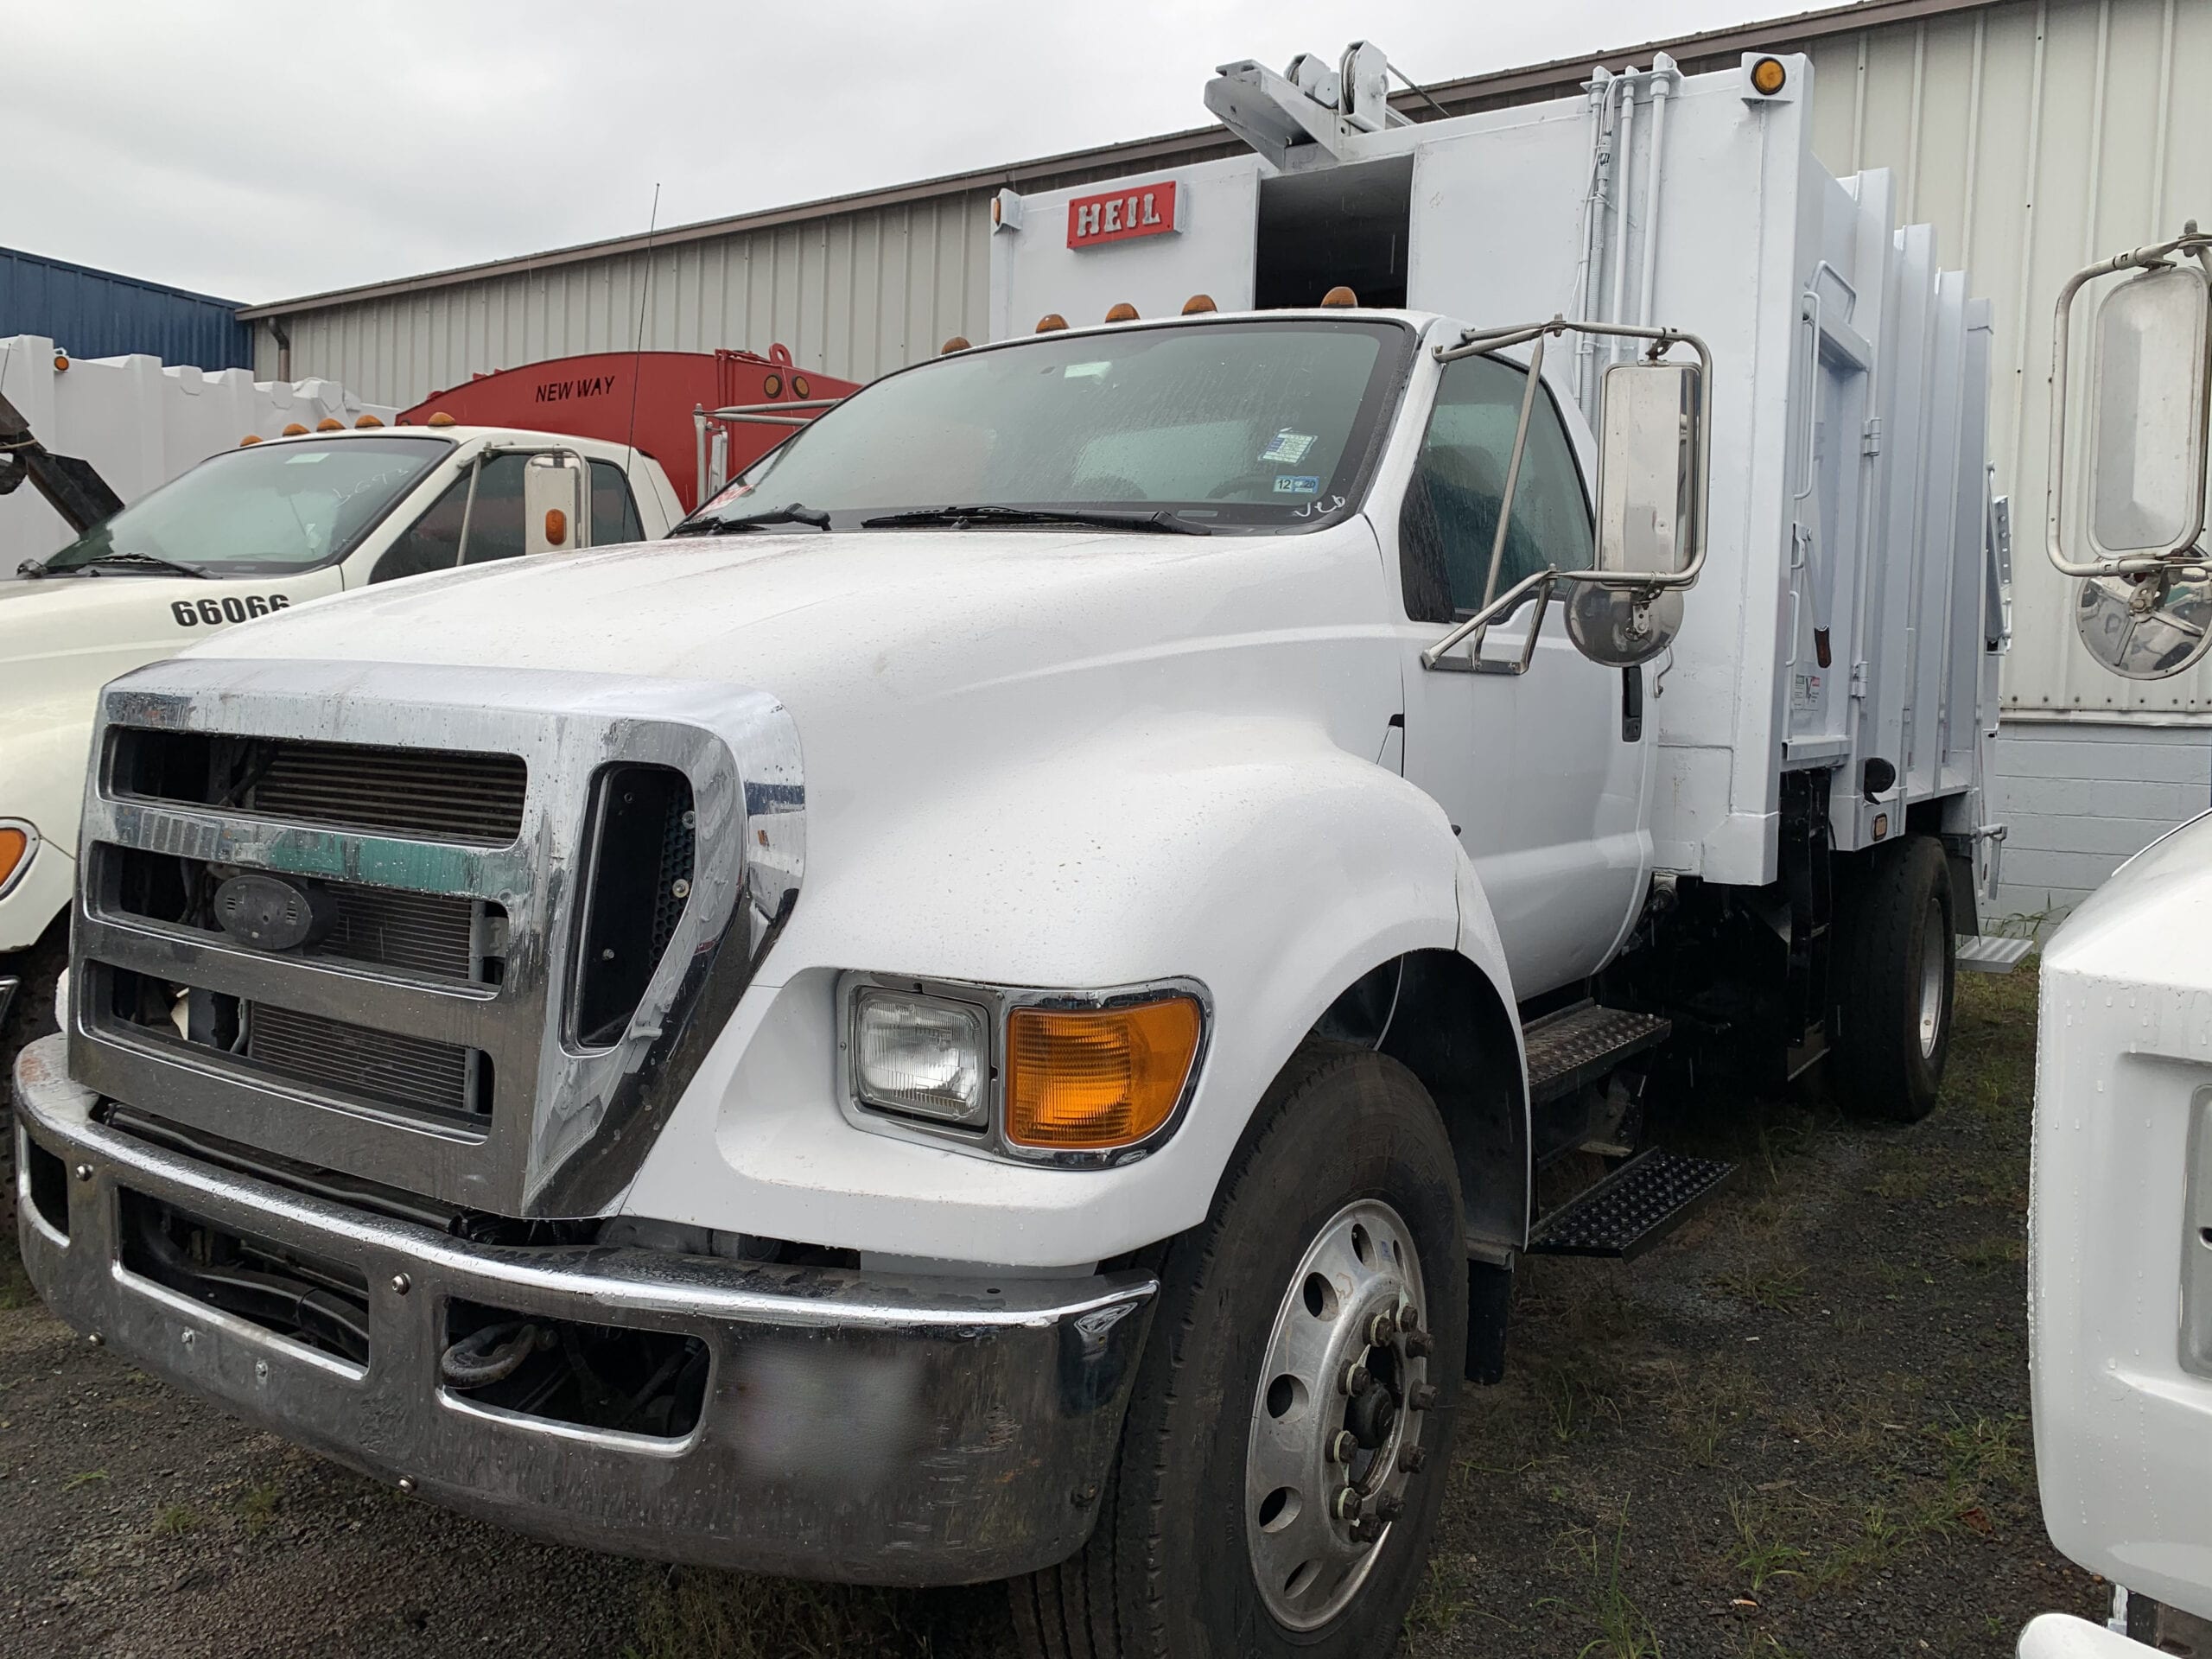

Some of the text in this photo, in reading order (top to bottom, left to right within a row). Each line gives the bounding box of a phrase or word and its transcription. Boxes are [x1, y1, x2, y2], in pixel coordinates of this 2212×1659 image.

[1077, 194, 1160, 238] HEIL
[536, 375, 615, 403] NEW WAY
[1278, 480, 1291, 490] 12
[170, 594, 290, 626] 66066
